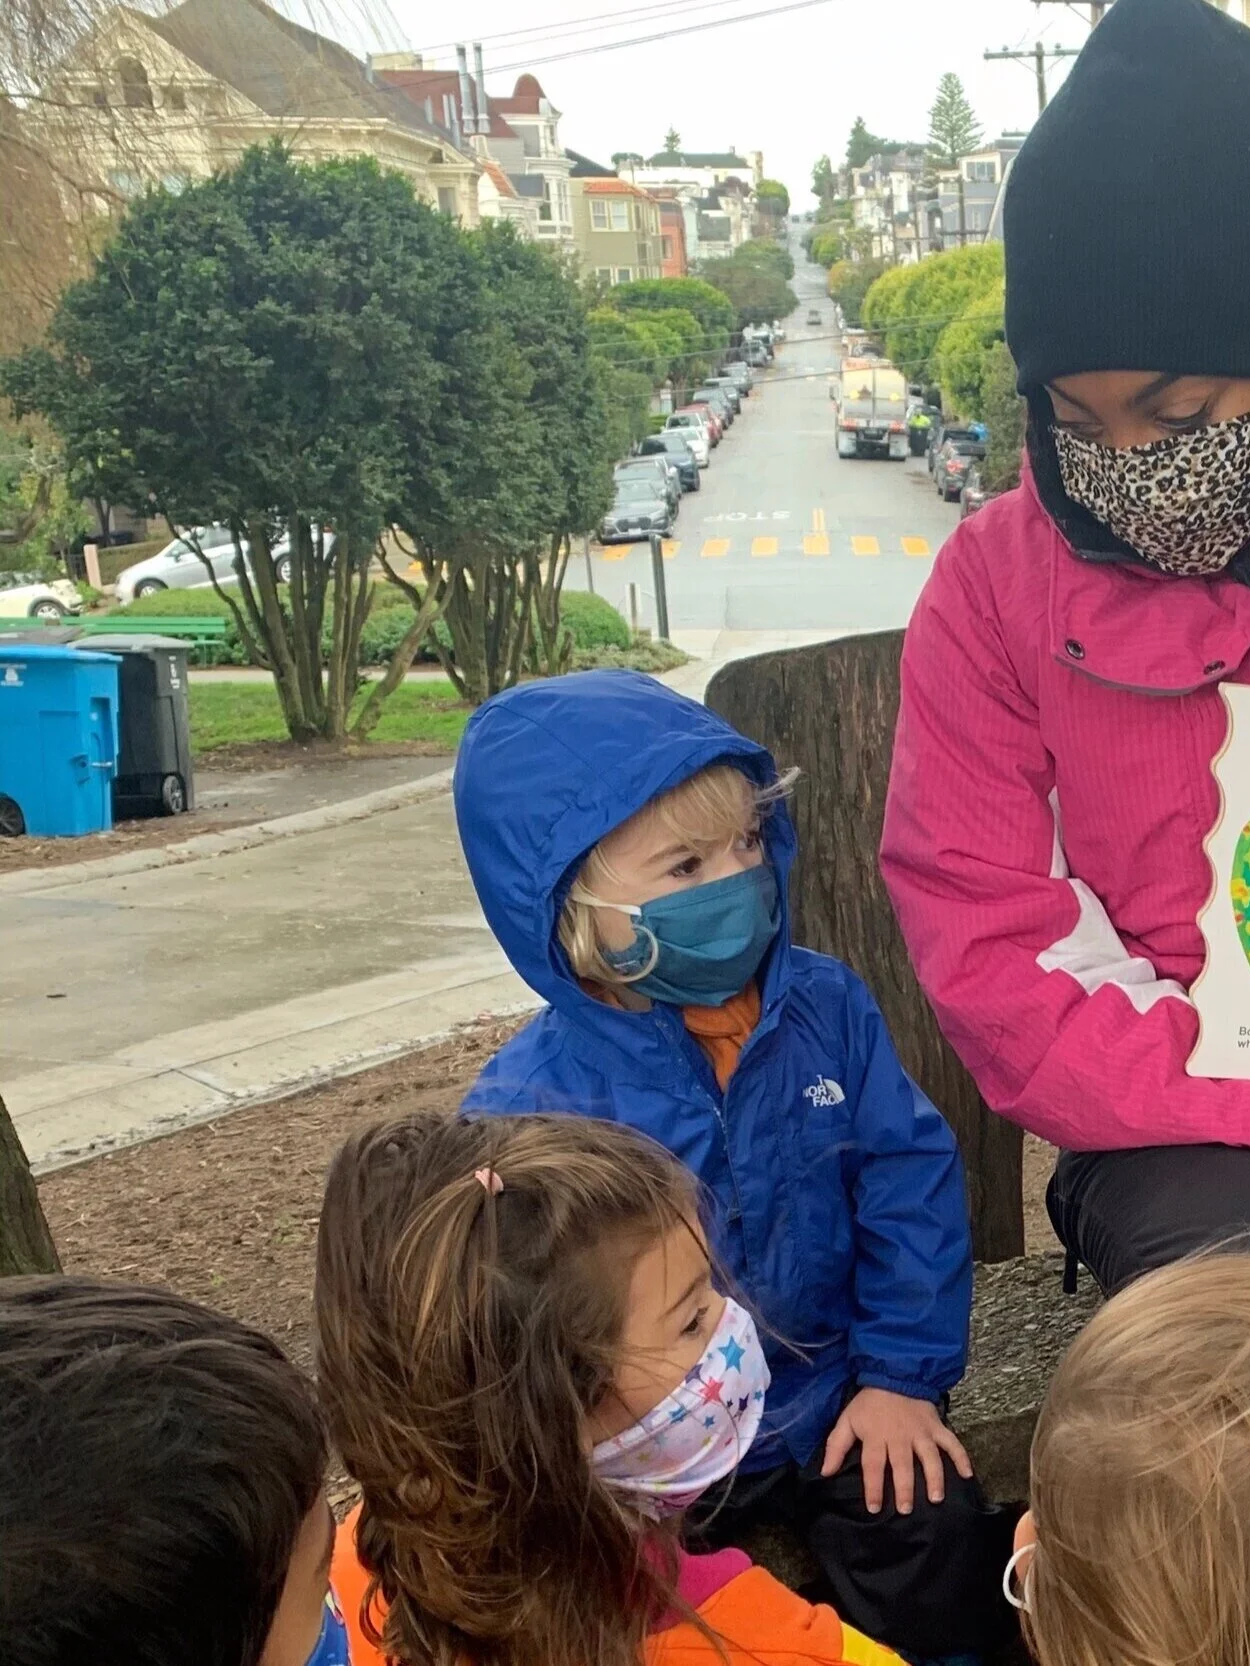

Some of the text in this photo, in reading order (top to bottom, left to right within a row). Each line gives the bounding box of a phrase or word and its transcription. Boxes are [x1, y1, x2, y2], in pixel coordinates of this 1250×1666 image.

[703, 510, 792, 522] STOP
[803, 1085, 827, 1098] NOR
[812, 1095, 839, 1107] FAC
